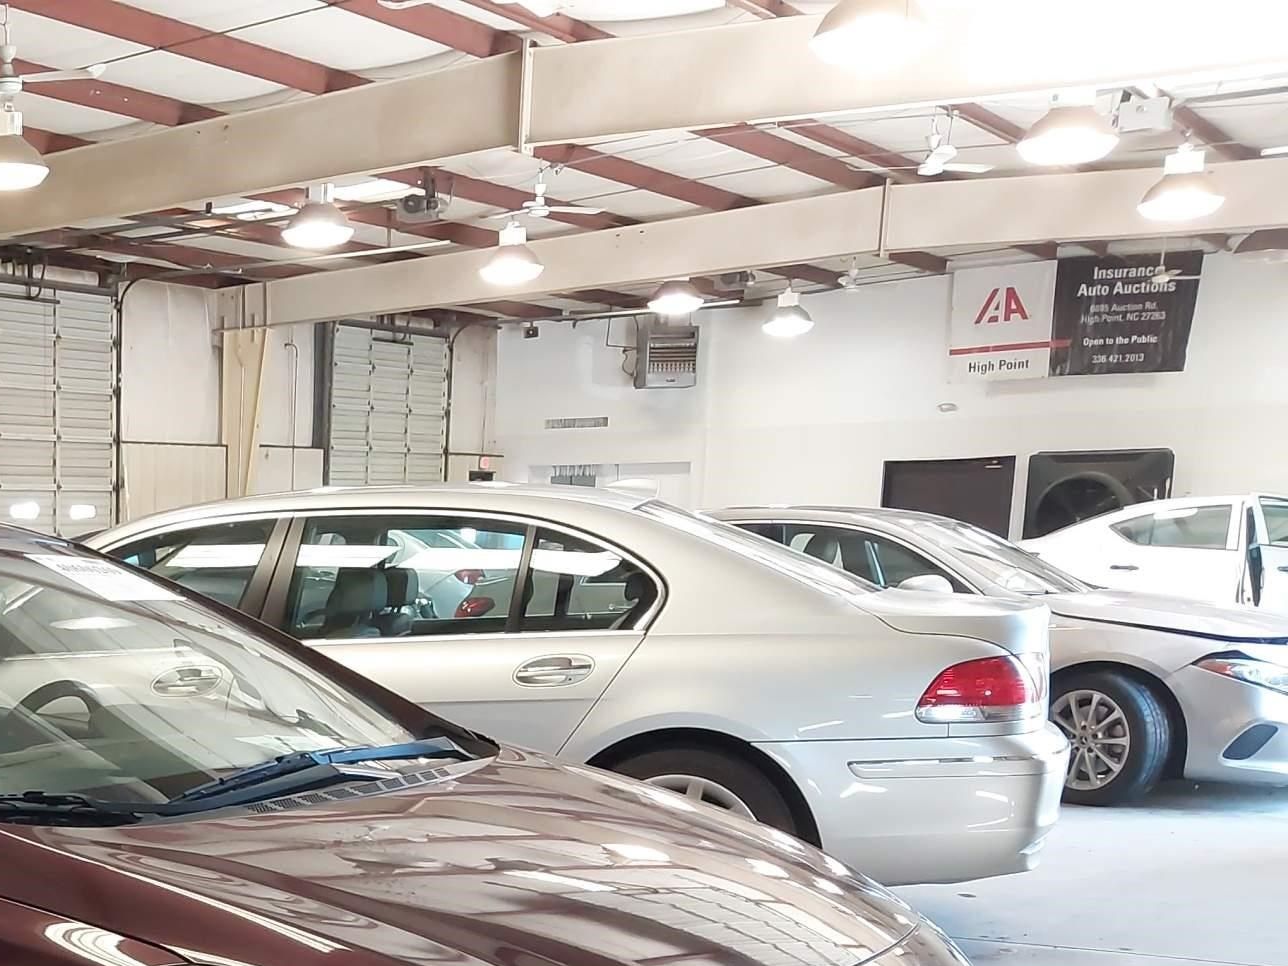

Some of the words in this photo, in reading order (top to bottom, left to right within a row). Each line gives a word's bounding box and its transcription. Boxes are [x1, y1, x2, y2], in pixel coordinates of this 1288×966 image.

[1077, 283, 1110, 297] Auto
[1112, 281, 1177, 296] Auctions
[1110, 303, 1143, 312] Auction
[1080, 314, 1100, 326] High
[1126, 312, 1140, 321] NC
[1082, 337, 1104, 348] Open
[1106, 337, 1114, 345] to
[1115, 335, 1129, 345] the
[1131, 334, 1158, 344] Public
[968, 360, 995, 375] High
[998, 358, 1030, 371] Point
